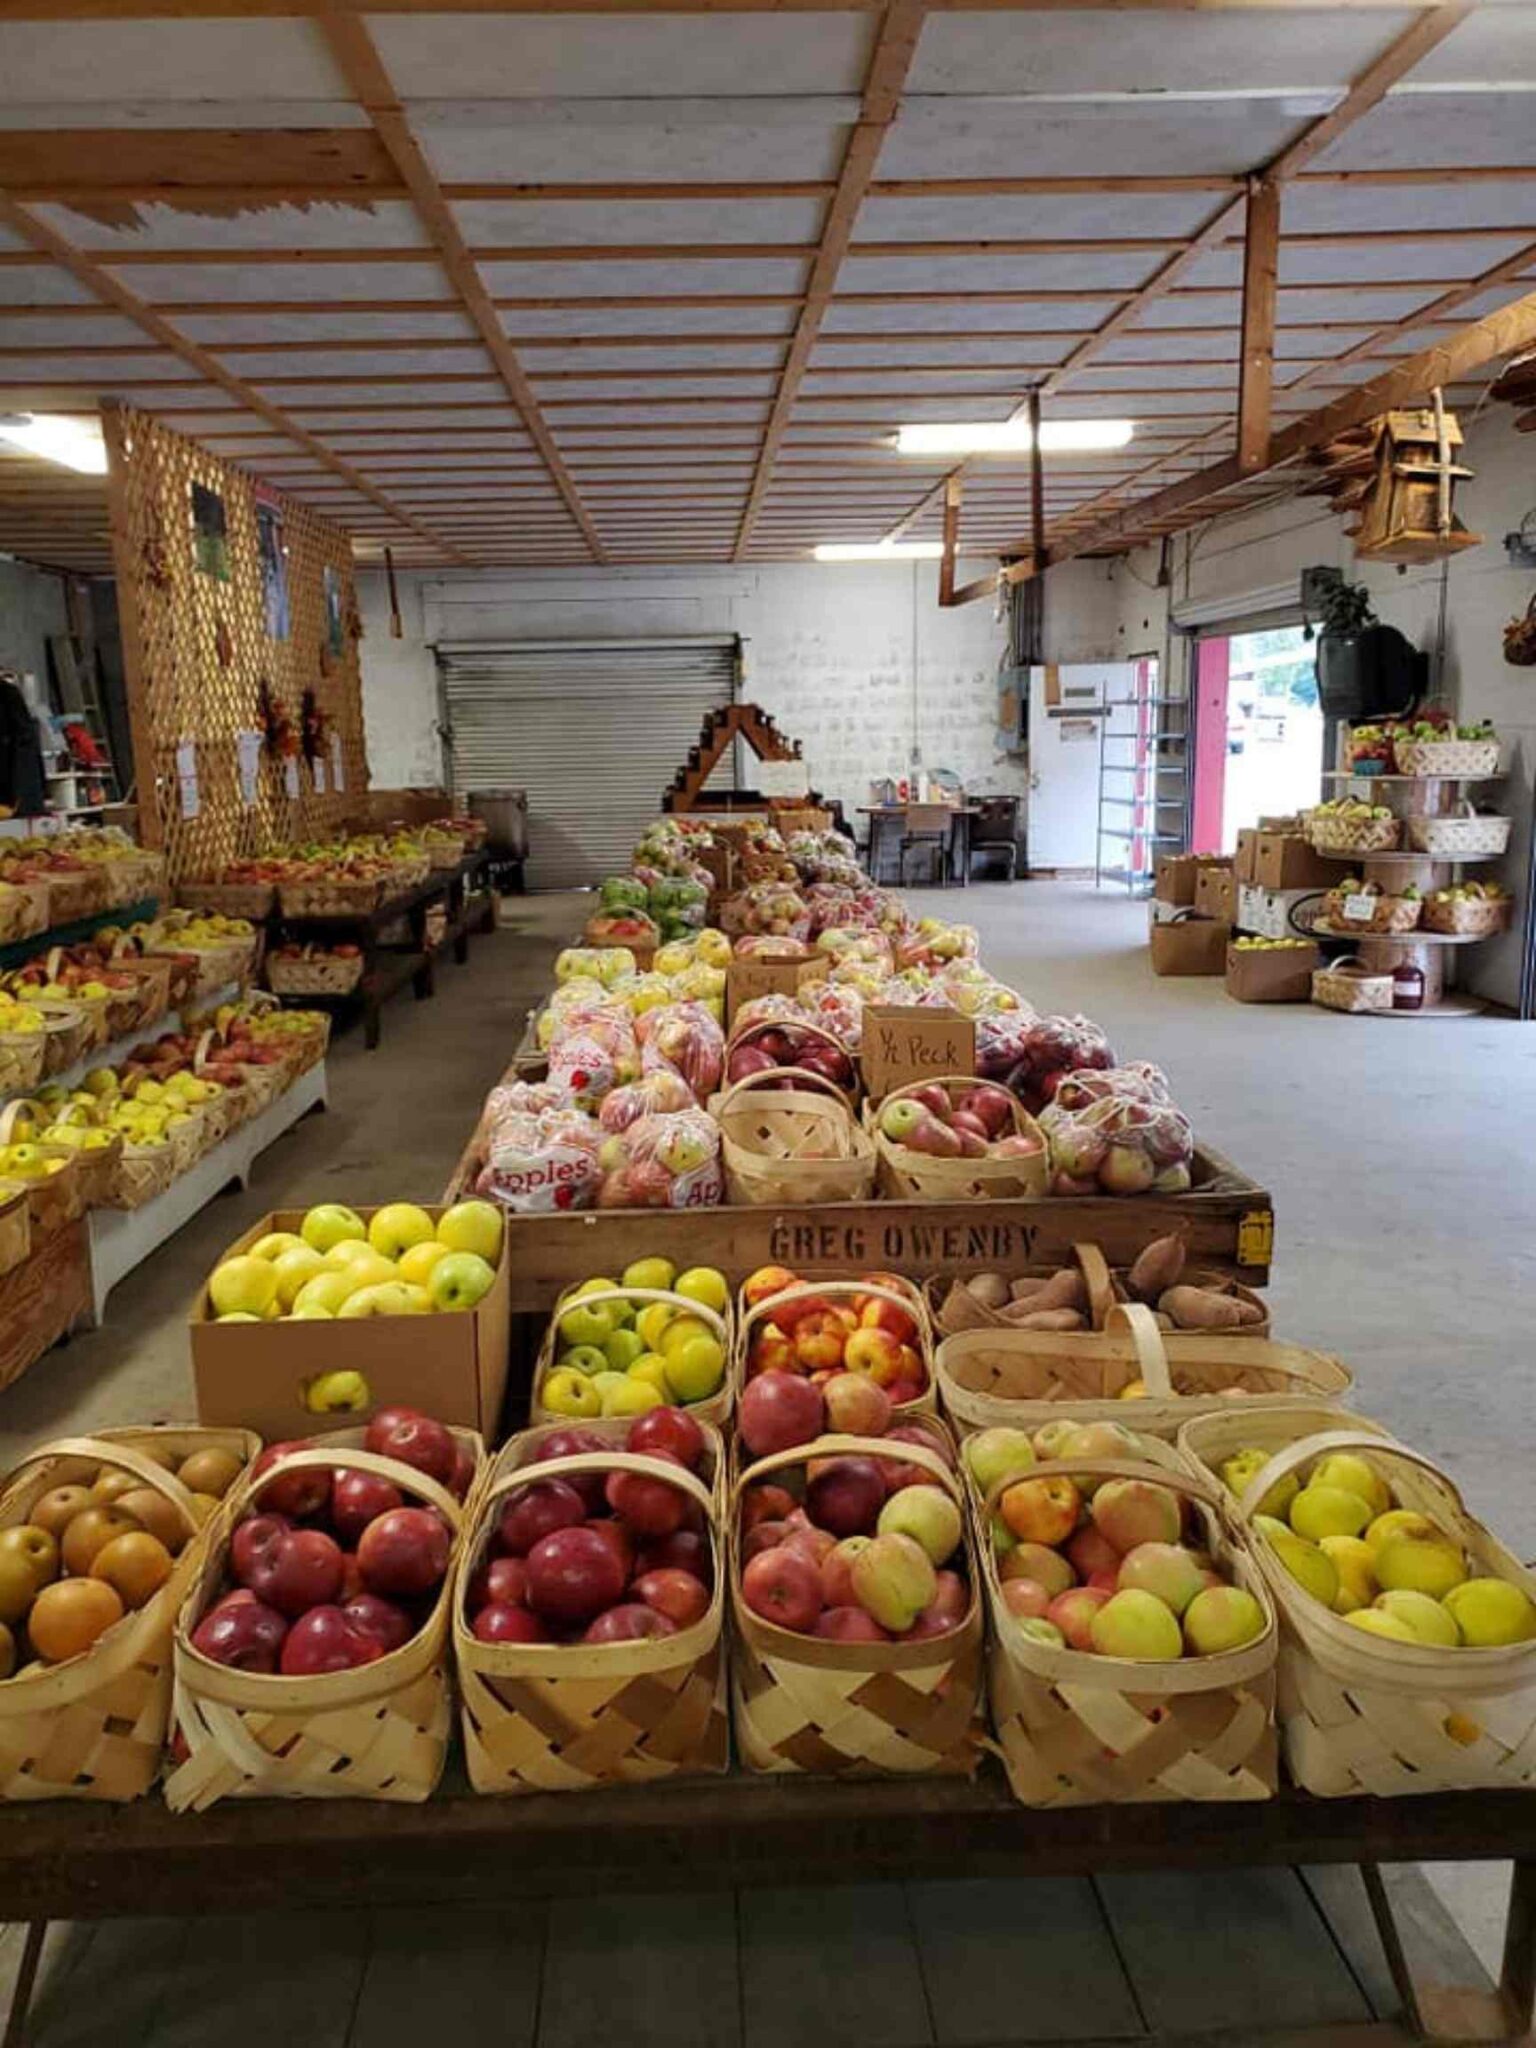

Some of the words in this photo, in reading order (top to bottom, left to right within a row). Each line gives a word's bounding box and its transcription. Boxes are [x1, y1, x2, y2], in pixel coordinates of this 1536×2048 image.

[907, 1034, 959, 1067] Peck
[769, 1225, 865, 1260] GREG
[884, 1224, 1040, 1260] OWENBY
